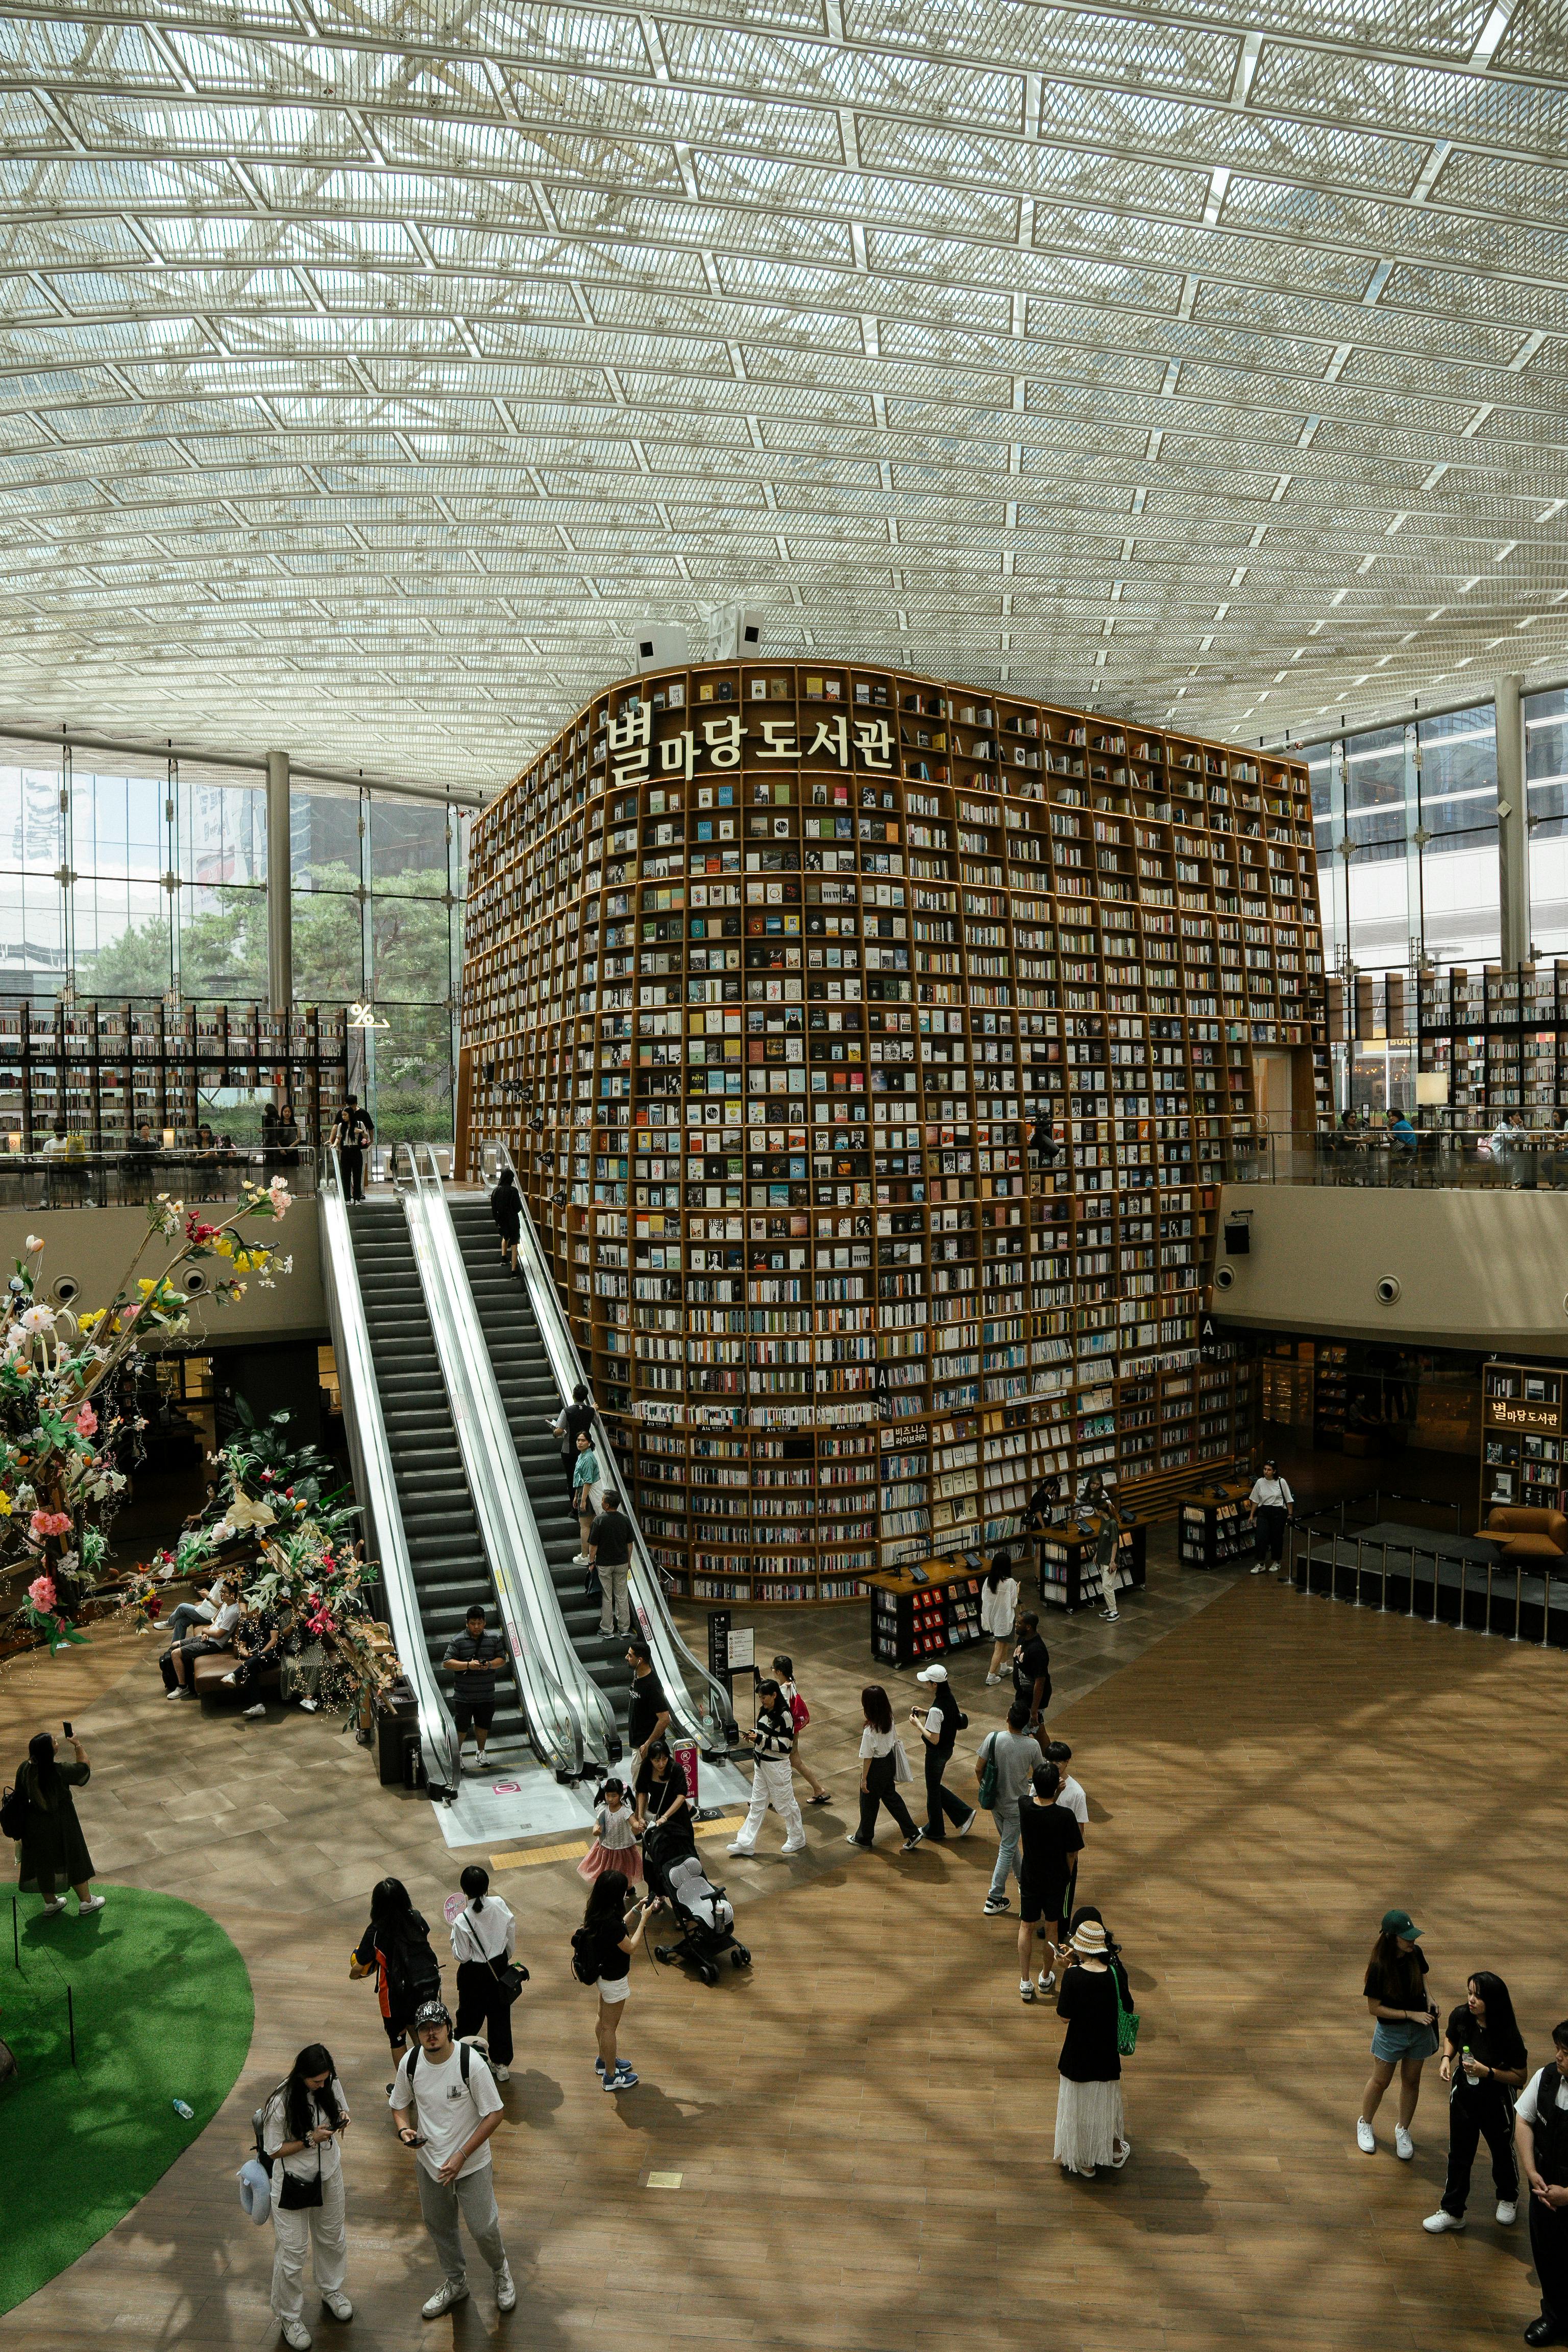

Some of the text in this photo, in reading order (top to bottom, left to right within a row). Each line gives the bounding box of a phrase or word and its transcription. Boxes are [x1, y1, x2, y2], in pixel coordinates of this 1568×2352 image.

[607, 701, 895, 787] 별마당 도서관
[1203, 1320, 1213, 1335] A
[1202, 1345, 1215, 1354] 소설
[879, 1369, 886, 1388] A
[1492, 1402, 1558, 1426] 별마당 도서관
[895, 1424, 926, 1436] 비즈니스
[896, 1433, 927, 1446] 라이브러리
[423, 2005, 432, 2015] NY
[613, 2075, 626, 2084] N
